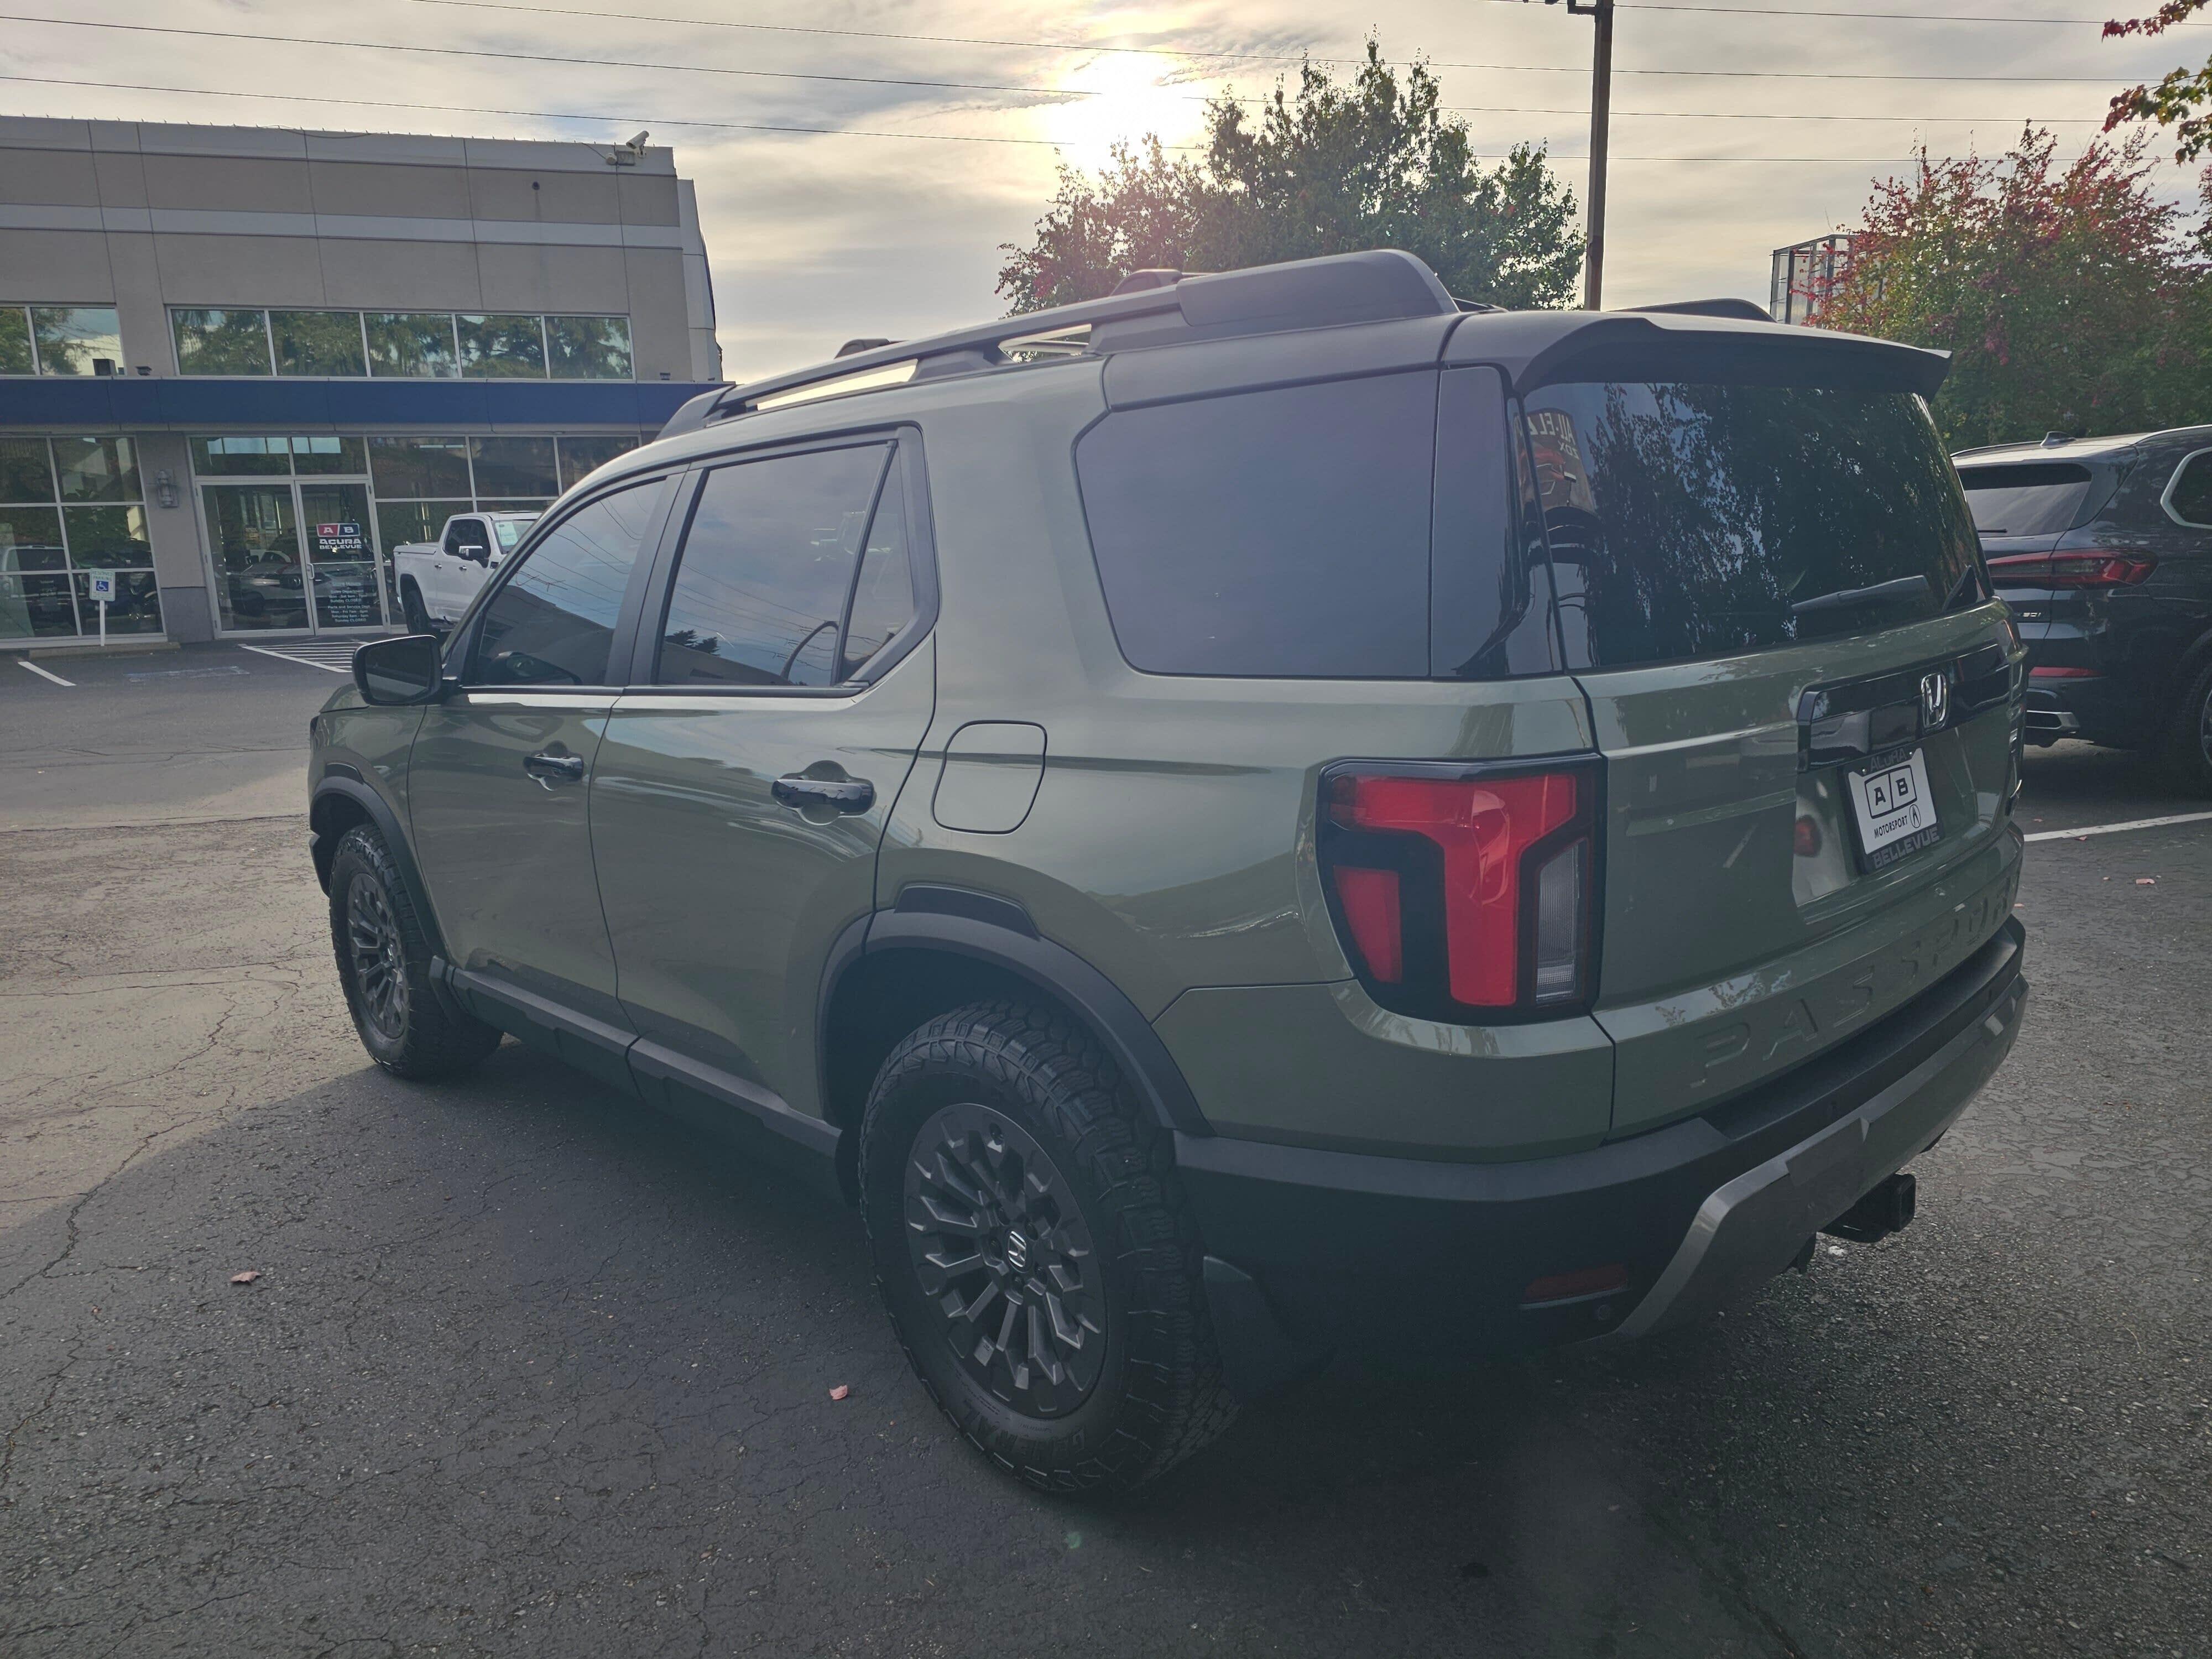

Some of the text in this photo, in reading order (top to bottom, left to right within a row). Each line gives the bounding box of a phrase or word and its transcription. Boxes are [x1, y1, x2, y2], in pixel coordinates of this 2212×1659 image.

[1872, 826, 1940, 869] BELLEVUE
[1874, 815, 1908, 839] MOTORSPORT
[1689, 875, 2014, 1088] PASSPOR
